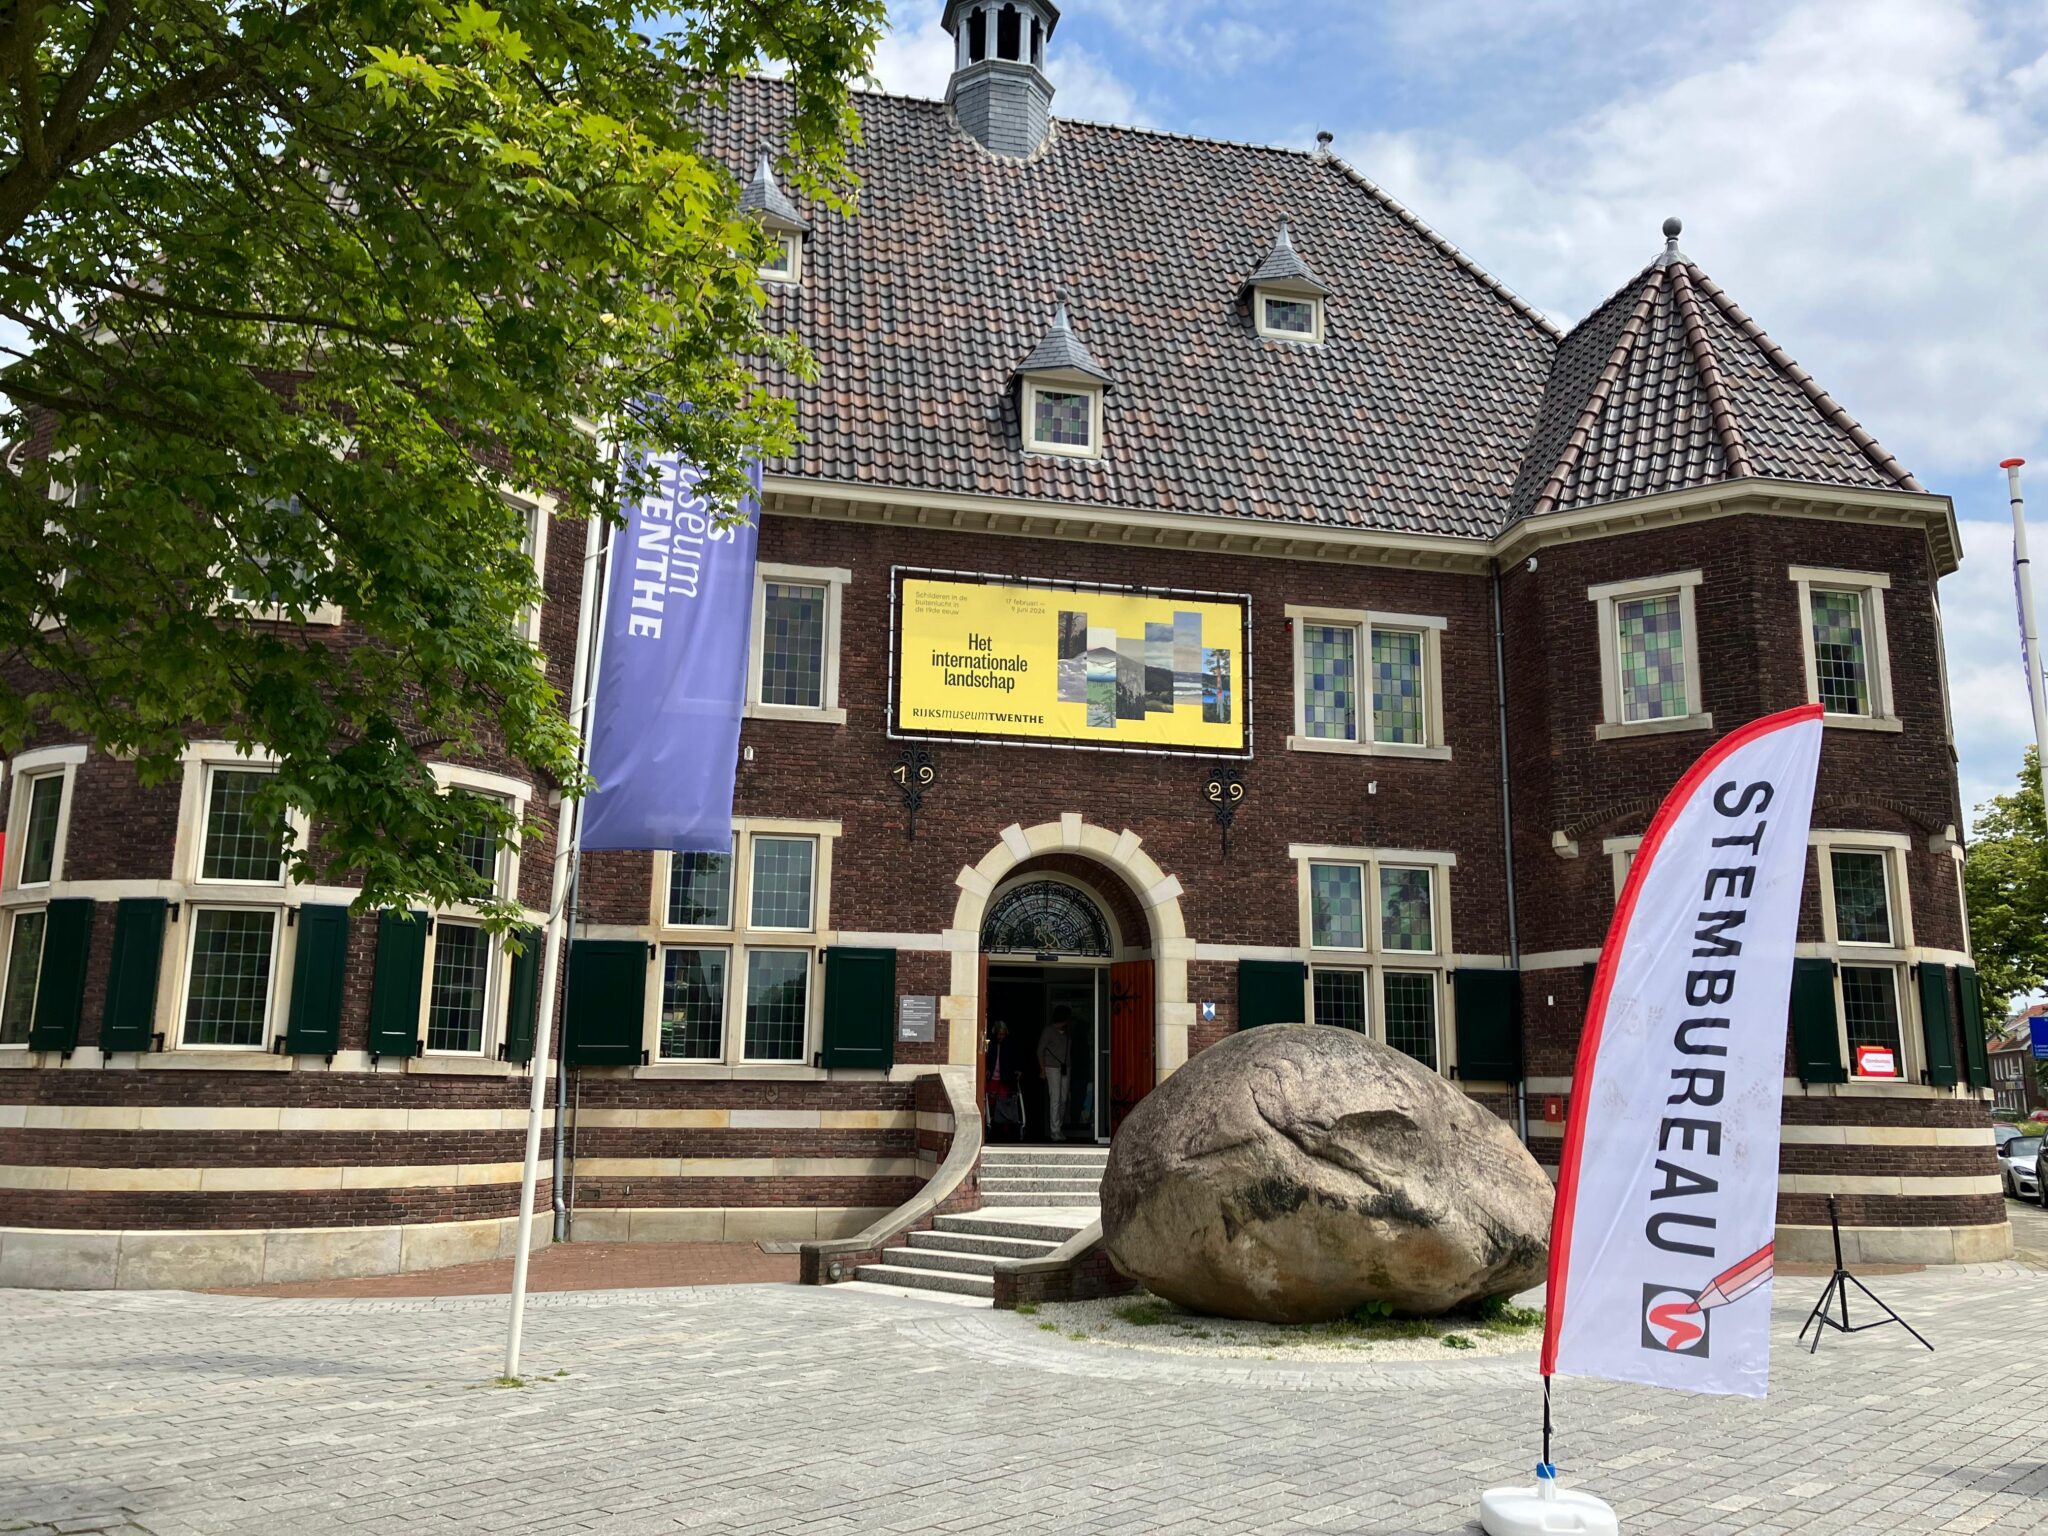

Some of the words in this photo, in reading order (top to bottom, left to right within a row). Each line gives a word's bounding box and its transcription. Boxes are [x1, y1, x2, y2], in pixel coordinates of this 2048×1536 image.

[669, 452, 709, 599] useum
[628, 451, 679, 640] WENTHE
[915, 591, 950, 601] Schilderen
[959, 594, 968, 602] de
[915, 599, 952, 608] buitenlucht
[1013, 599, 1039, 607] februari
[925, 606, 941, 614] 19de
[1016, 606, 1029, 614] juni
[1029, 607, 1046, 615] 2024
[968, 632, 993, 652] Het
[931, 649, 1028, 673] internationale
[944, 667, 1016, 694] landschap
[912, 707, 1045, 724] RIJKSmuseumTWENTHE
[893, 765, 935, 785] 19
[1208, 781, 1245, 801] 29
[1644, 779, 1775, 1259] STEMBUREAU
